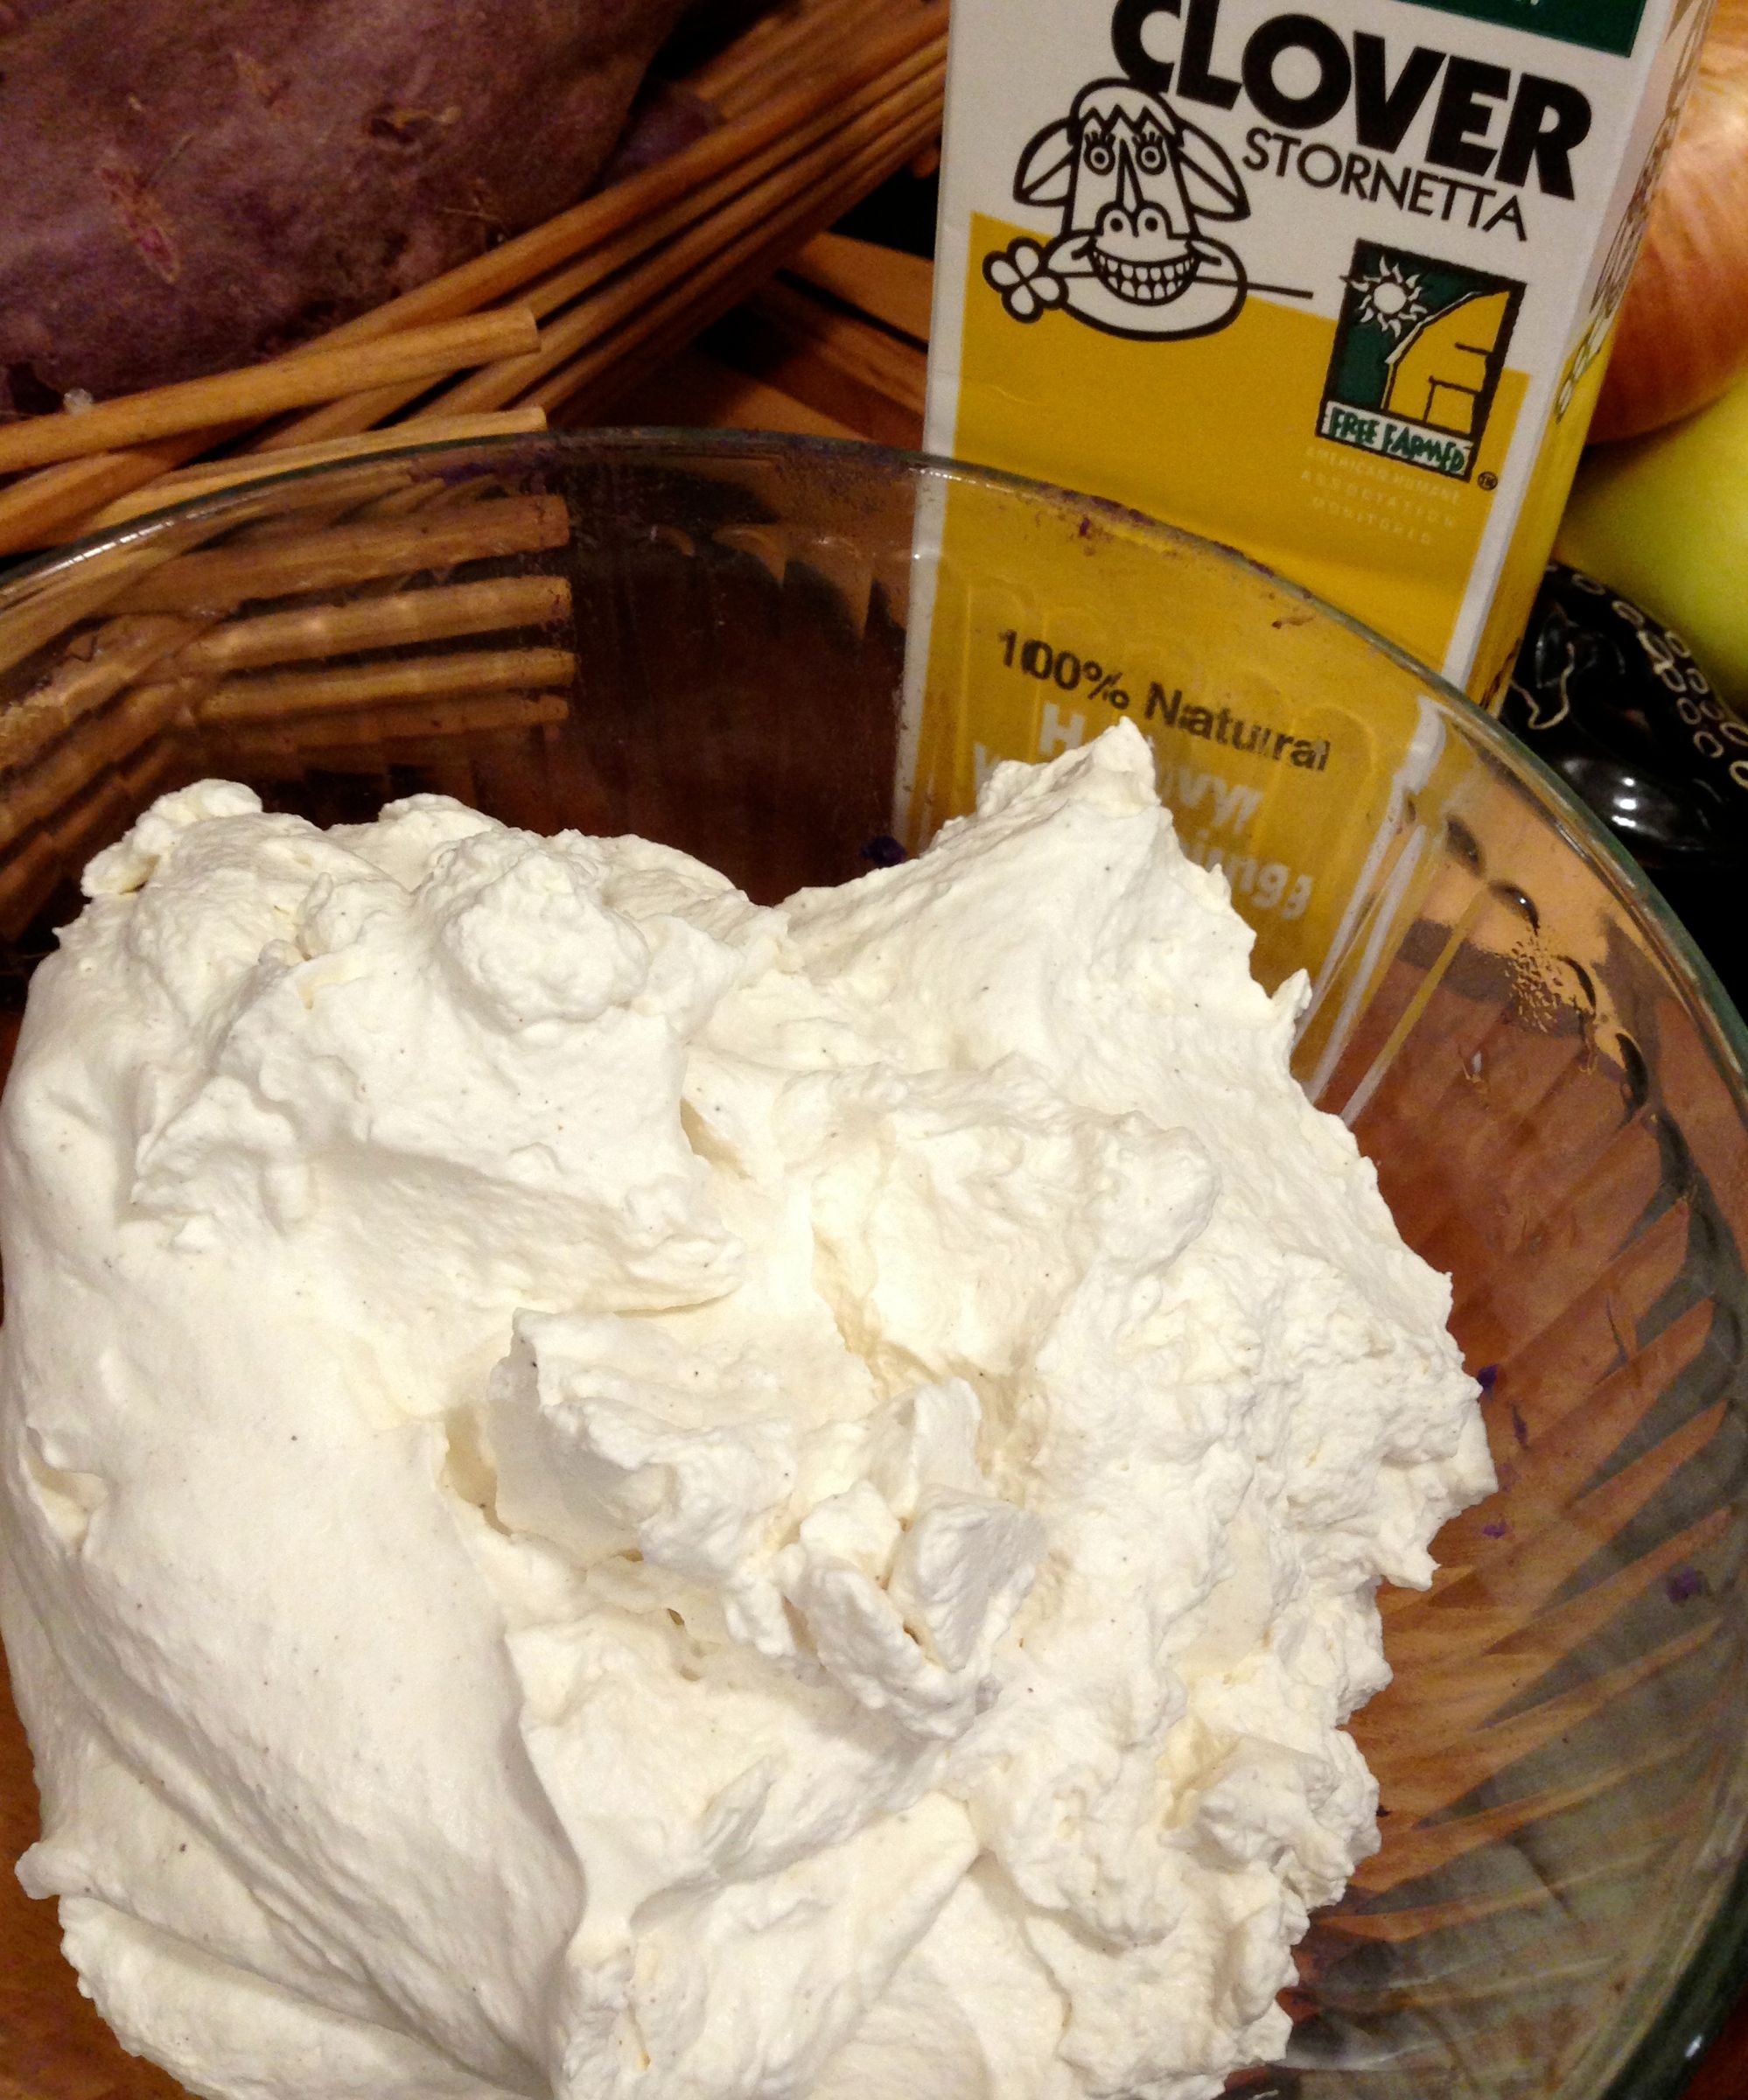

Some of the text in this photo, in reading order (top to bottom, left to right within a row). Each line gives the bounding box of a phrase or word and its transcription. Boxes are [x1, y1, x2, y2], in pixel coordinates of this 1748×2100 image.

[1111, 0, 1591, 200] CLOVER
[1242, 127, 1527, 242] STORNETTA
[1329, 406, 1465, 472] FREE FARMED
[999, 629, 1331, 772] 100% Natural
